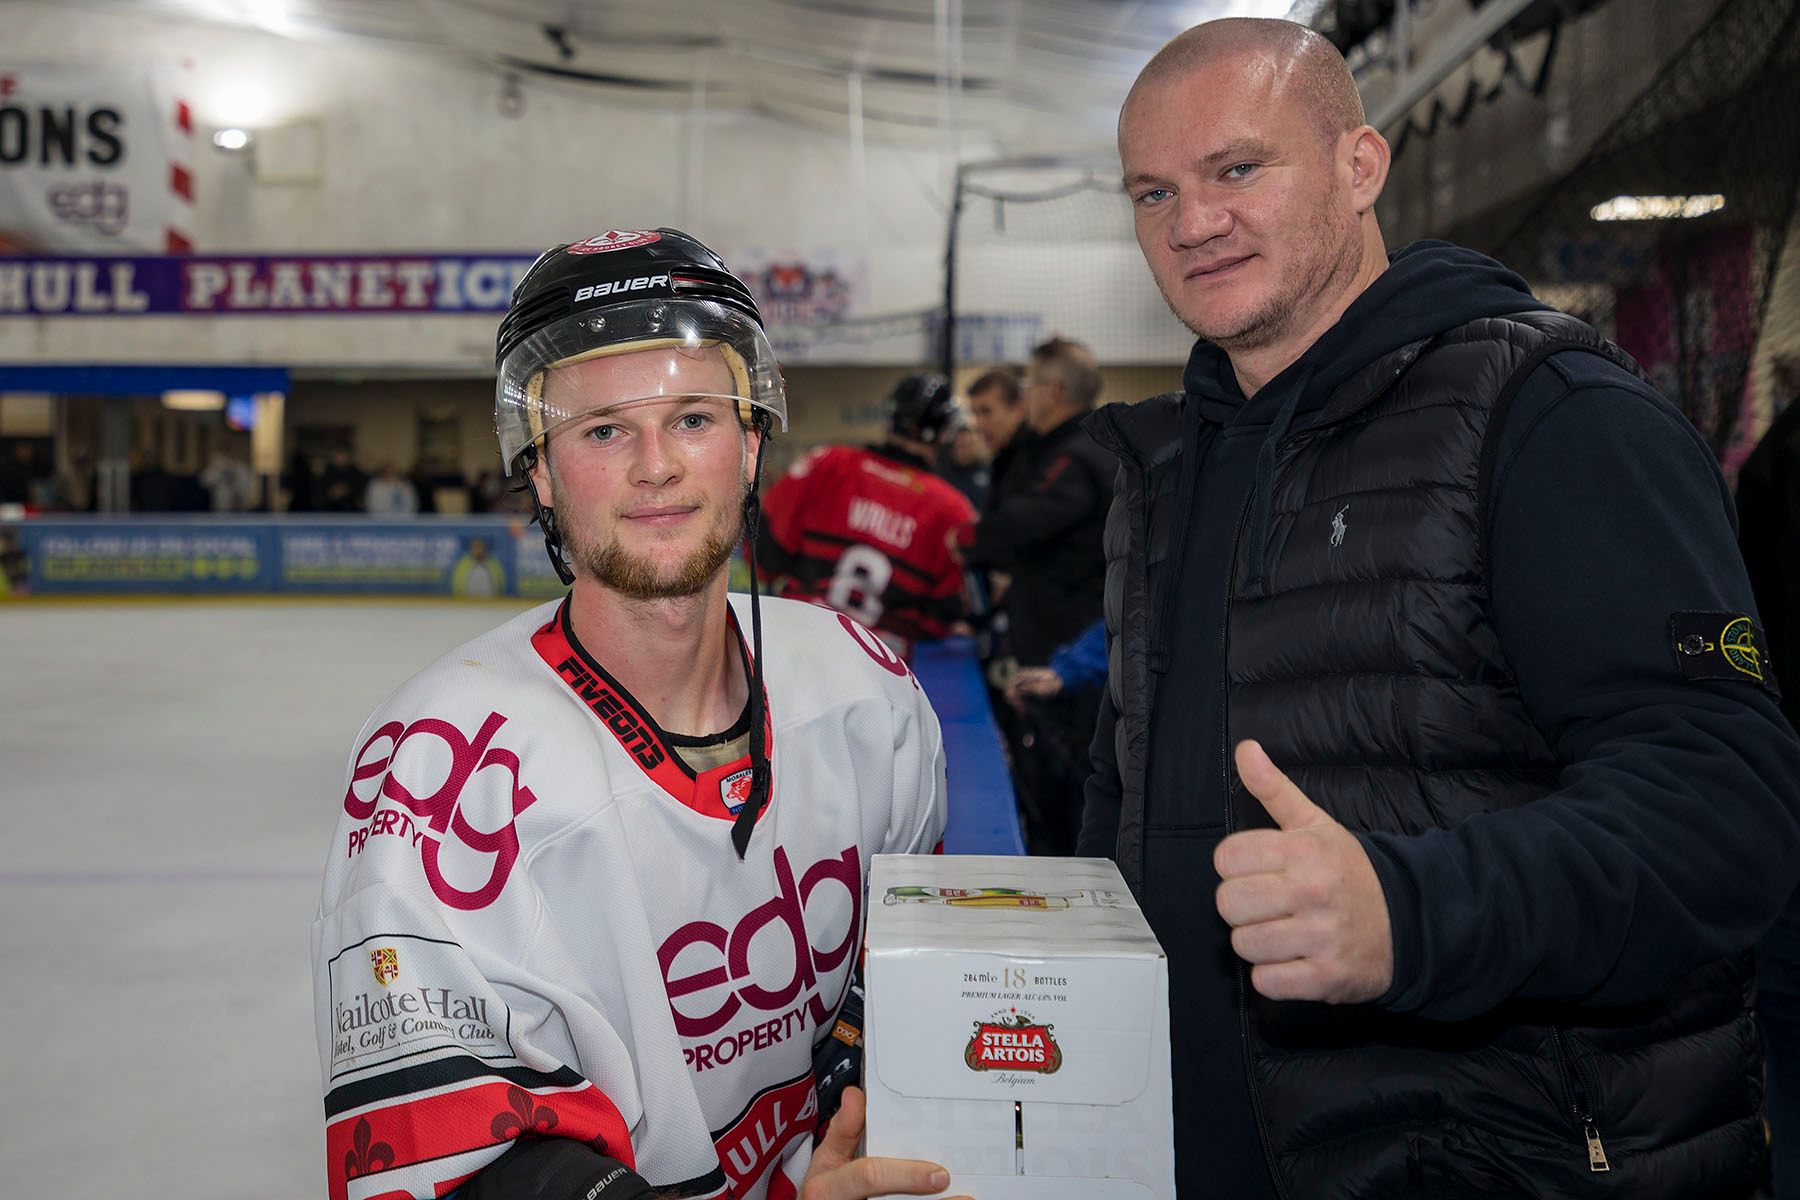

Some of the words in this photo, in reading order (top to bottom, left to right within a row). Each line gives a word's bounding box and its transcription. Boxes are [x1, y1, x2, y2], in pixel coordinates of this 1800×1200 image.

[344, 711, 538, 911] edg
[348, 809, 424, 858] PRERTY
[656, 844, 862, 1038] edg
[1003, 967, 1026, 989] 18
[1034, 977, 1067, 986] BOTTLES
[418, 988, 491, 1027] Hall
[961, 991, 996, 999] PREMIUM
[998, 992, 1021, 1000] LAGER
[360, 1026, 386, 1049] Golf
[388, 1022, 397, 1039] &
[459, 1024, 495, 1040] Club
[982, 1032, 1044, 1048] STELLA
[981, 1047, 1045, 1062] ARTOIS
[991, 1072, 1035, 1088] Belgium
